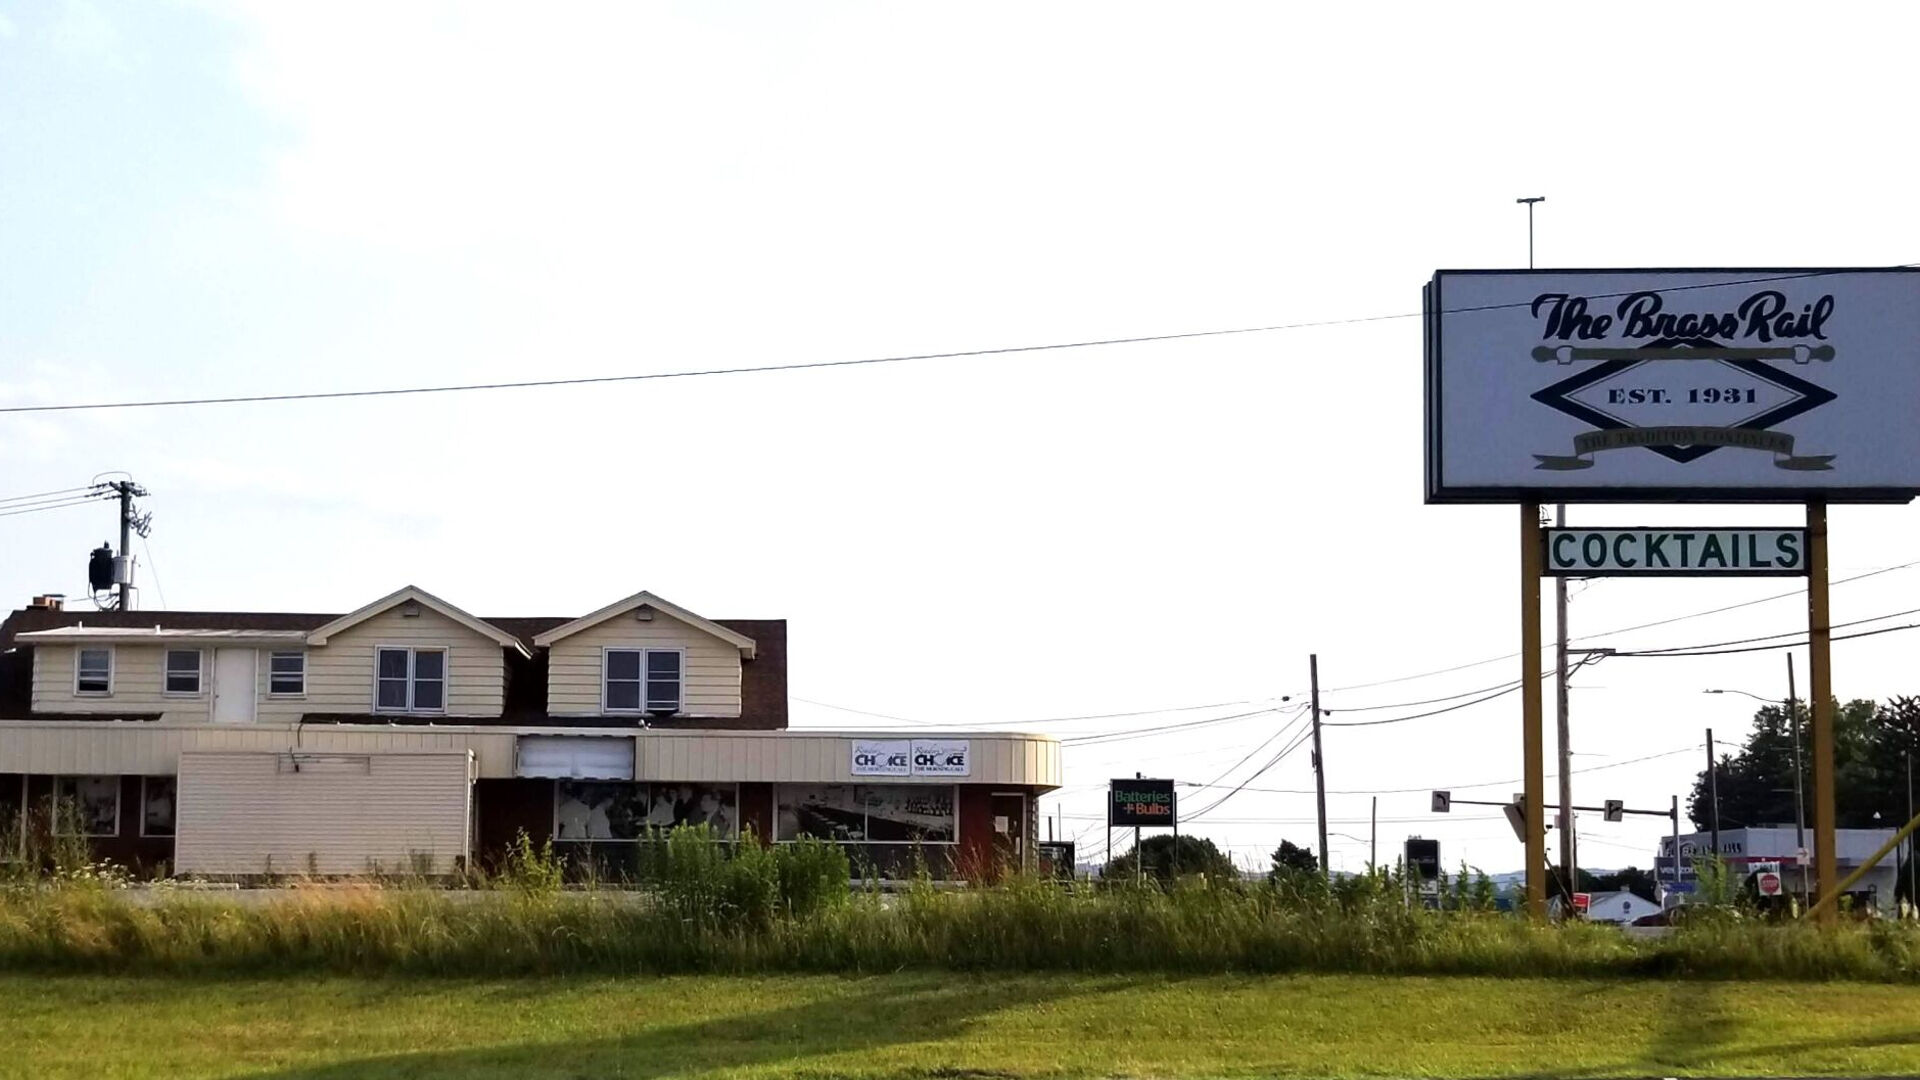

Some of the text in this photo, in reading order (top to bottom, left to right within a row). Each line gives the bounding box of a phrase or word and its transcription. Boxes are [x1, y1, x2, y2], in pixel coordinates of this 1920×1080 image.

[1531, 290, 1835, 343] The Brass Rail
[1608, 388, 1757, 404] EST. 1931
[1552, 533, 1800, 568] COCKTAILS
[855, 754, 907, 767] CHOICE
[914, 754, 964, 767] CHOICE
[1115, 790, 1170, 802] Batteries
